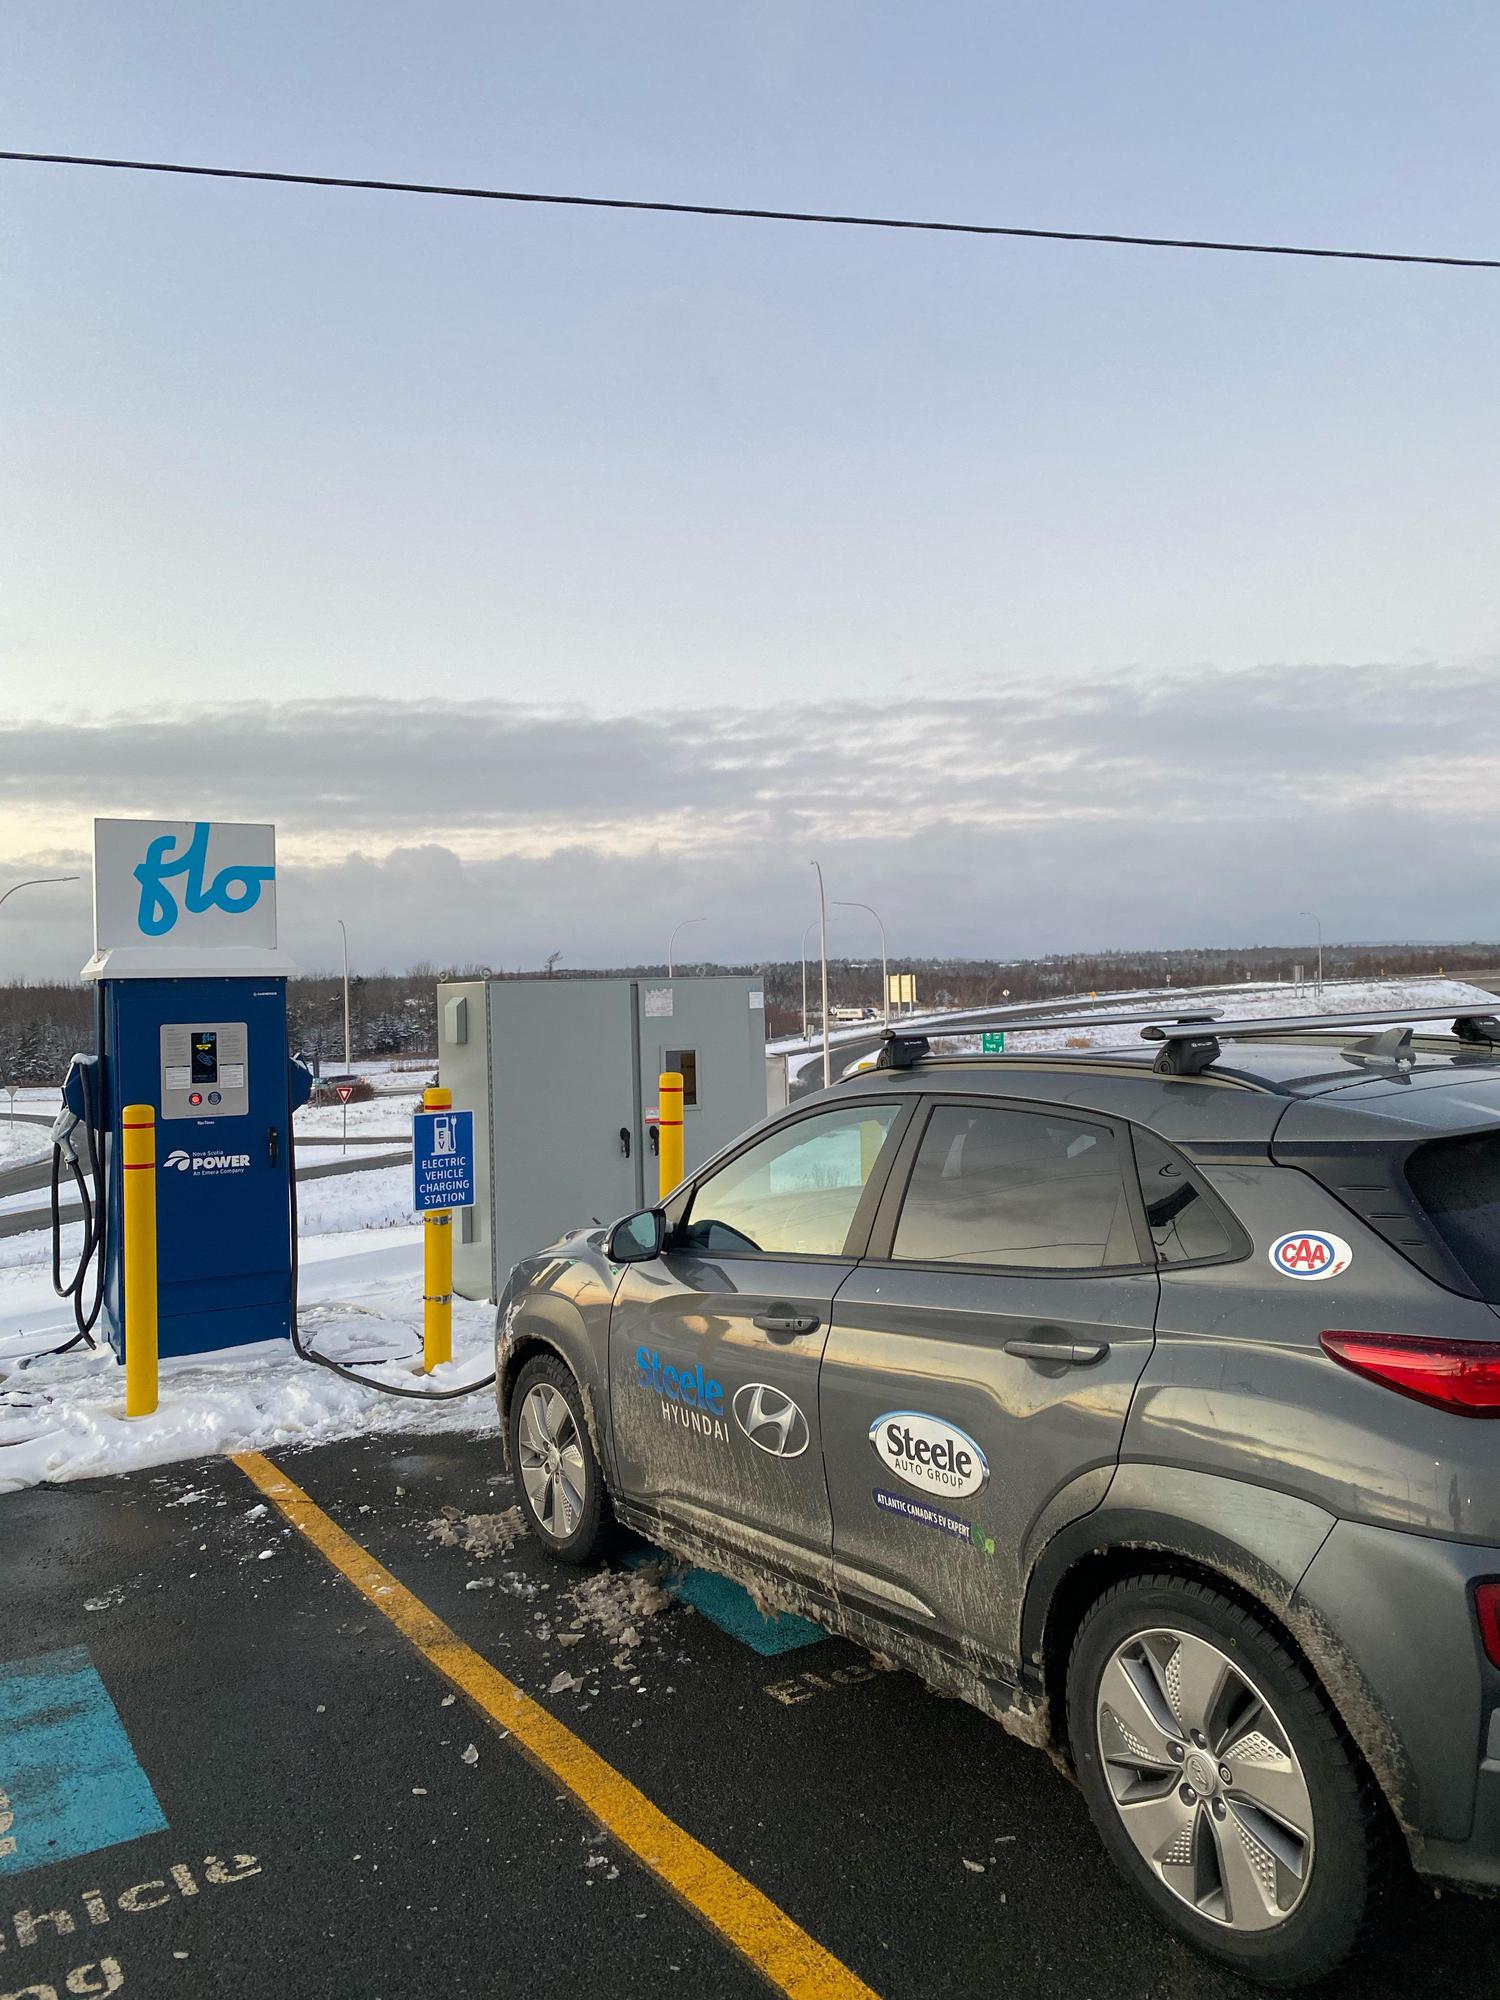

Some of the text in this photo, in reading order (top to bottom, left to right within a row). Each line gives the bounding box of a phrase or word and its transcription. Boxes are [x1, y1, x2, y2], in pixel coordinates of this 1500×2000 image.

[133, 822, 275, 936] flo
[192, 1154, 250, 1170] POWER
[422, 1157, 466, 1169] ELECTRIC
[425, 1169, 464, 1180] VEHICLE
[420, 1180, 470, 1193] CHARGING
[425, 1192, 465, 1205] STATION
[1282, 1239, 1326, 1269] CAA
[635, 1346, 724, 1417] Steele
[661, 1400, 729, 1443] HYUNDAI
[886, 1424, 972, 1478] Steele
[894, 1458, 964, 1488] AUTO GROUP
[877, 1494, 970, 1537] ATLANTIC CANADA'S EV EXPERT
